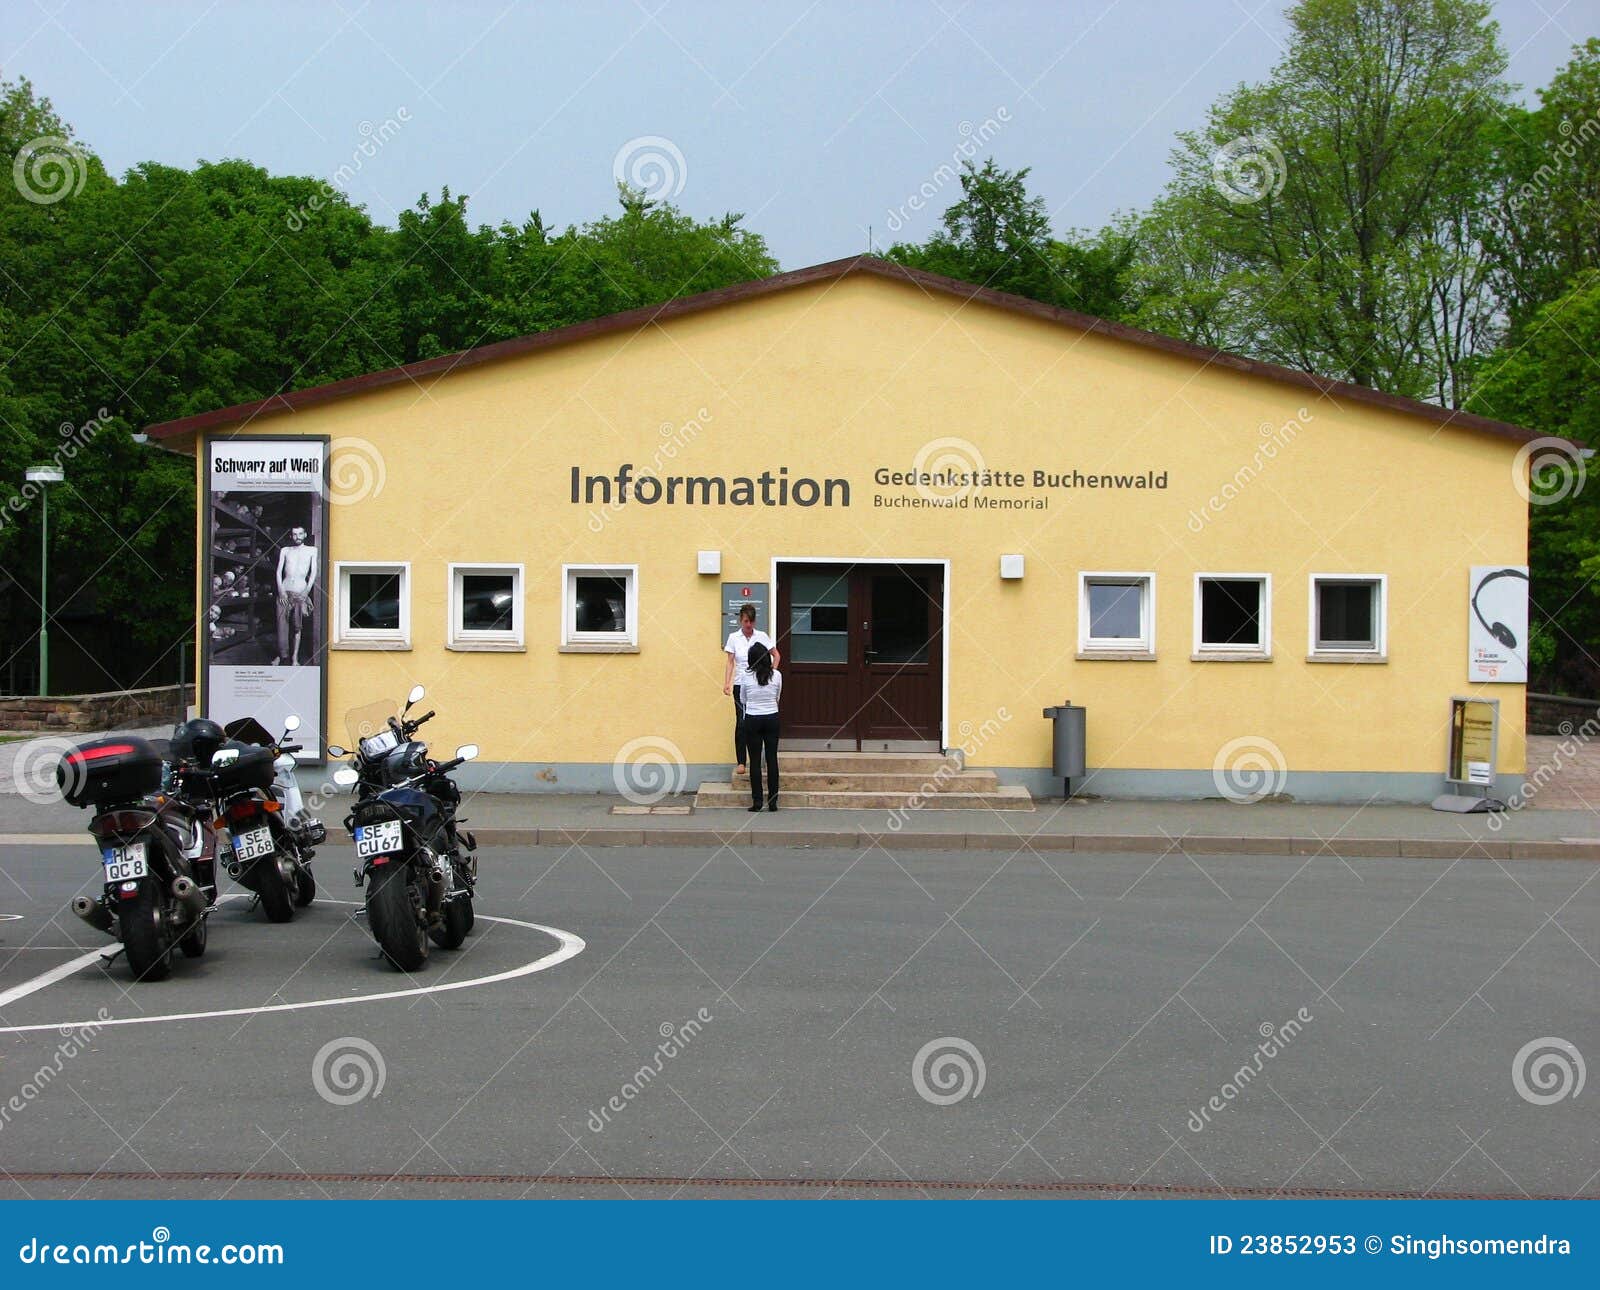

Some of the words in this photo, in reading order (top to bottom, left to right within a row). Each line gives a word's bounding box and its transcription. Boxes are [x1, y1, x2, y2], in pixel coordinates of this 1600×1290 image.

[215, 457, 266, 474] Schwarz
[269, 457, 288, 474] auf
[291, 457, 320, 474] Weiß
[570, 463, 850, 507] Information
[874, 468, 1025, 488] Gedenkstätte
[1033, 470, 1168, 490] Buchenwald
[873, 495, 969, 509] Buchenwald
[974, 496, 1049, 511] Memorial
[245, 830, 263, 846] SE
[363, 824, 383, 840] SE
[237, 845, 255, 860] ED
[257, 840, 273, 854] 68
[358, 840, 379, 856] CU
[381, 835, 400, 851] 67
[112, 847, 134, 864] HL
[109, 863, 131, 880] QC
[133, 860, 143, 875] 8
